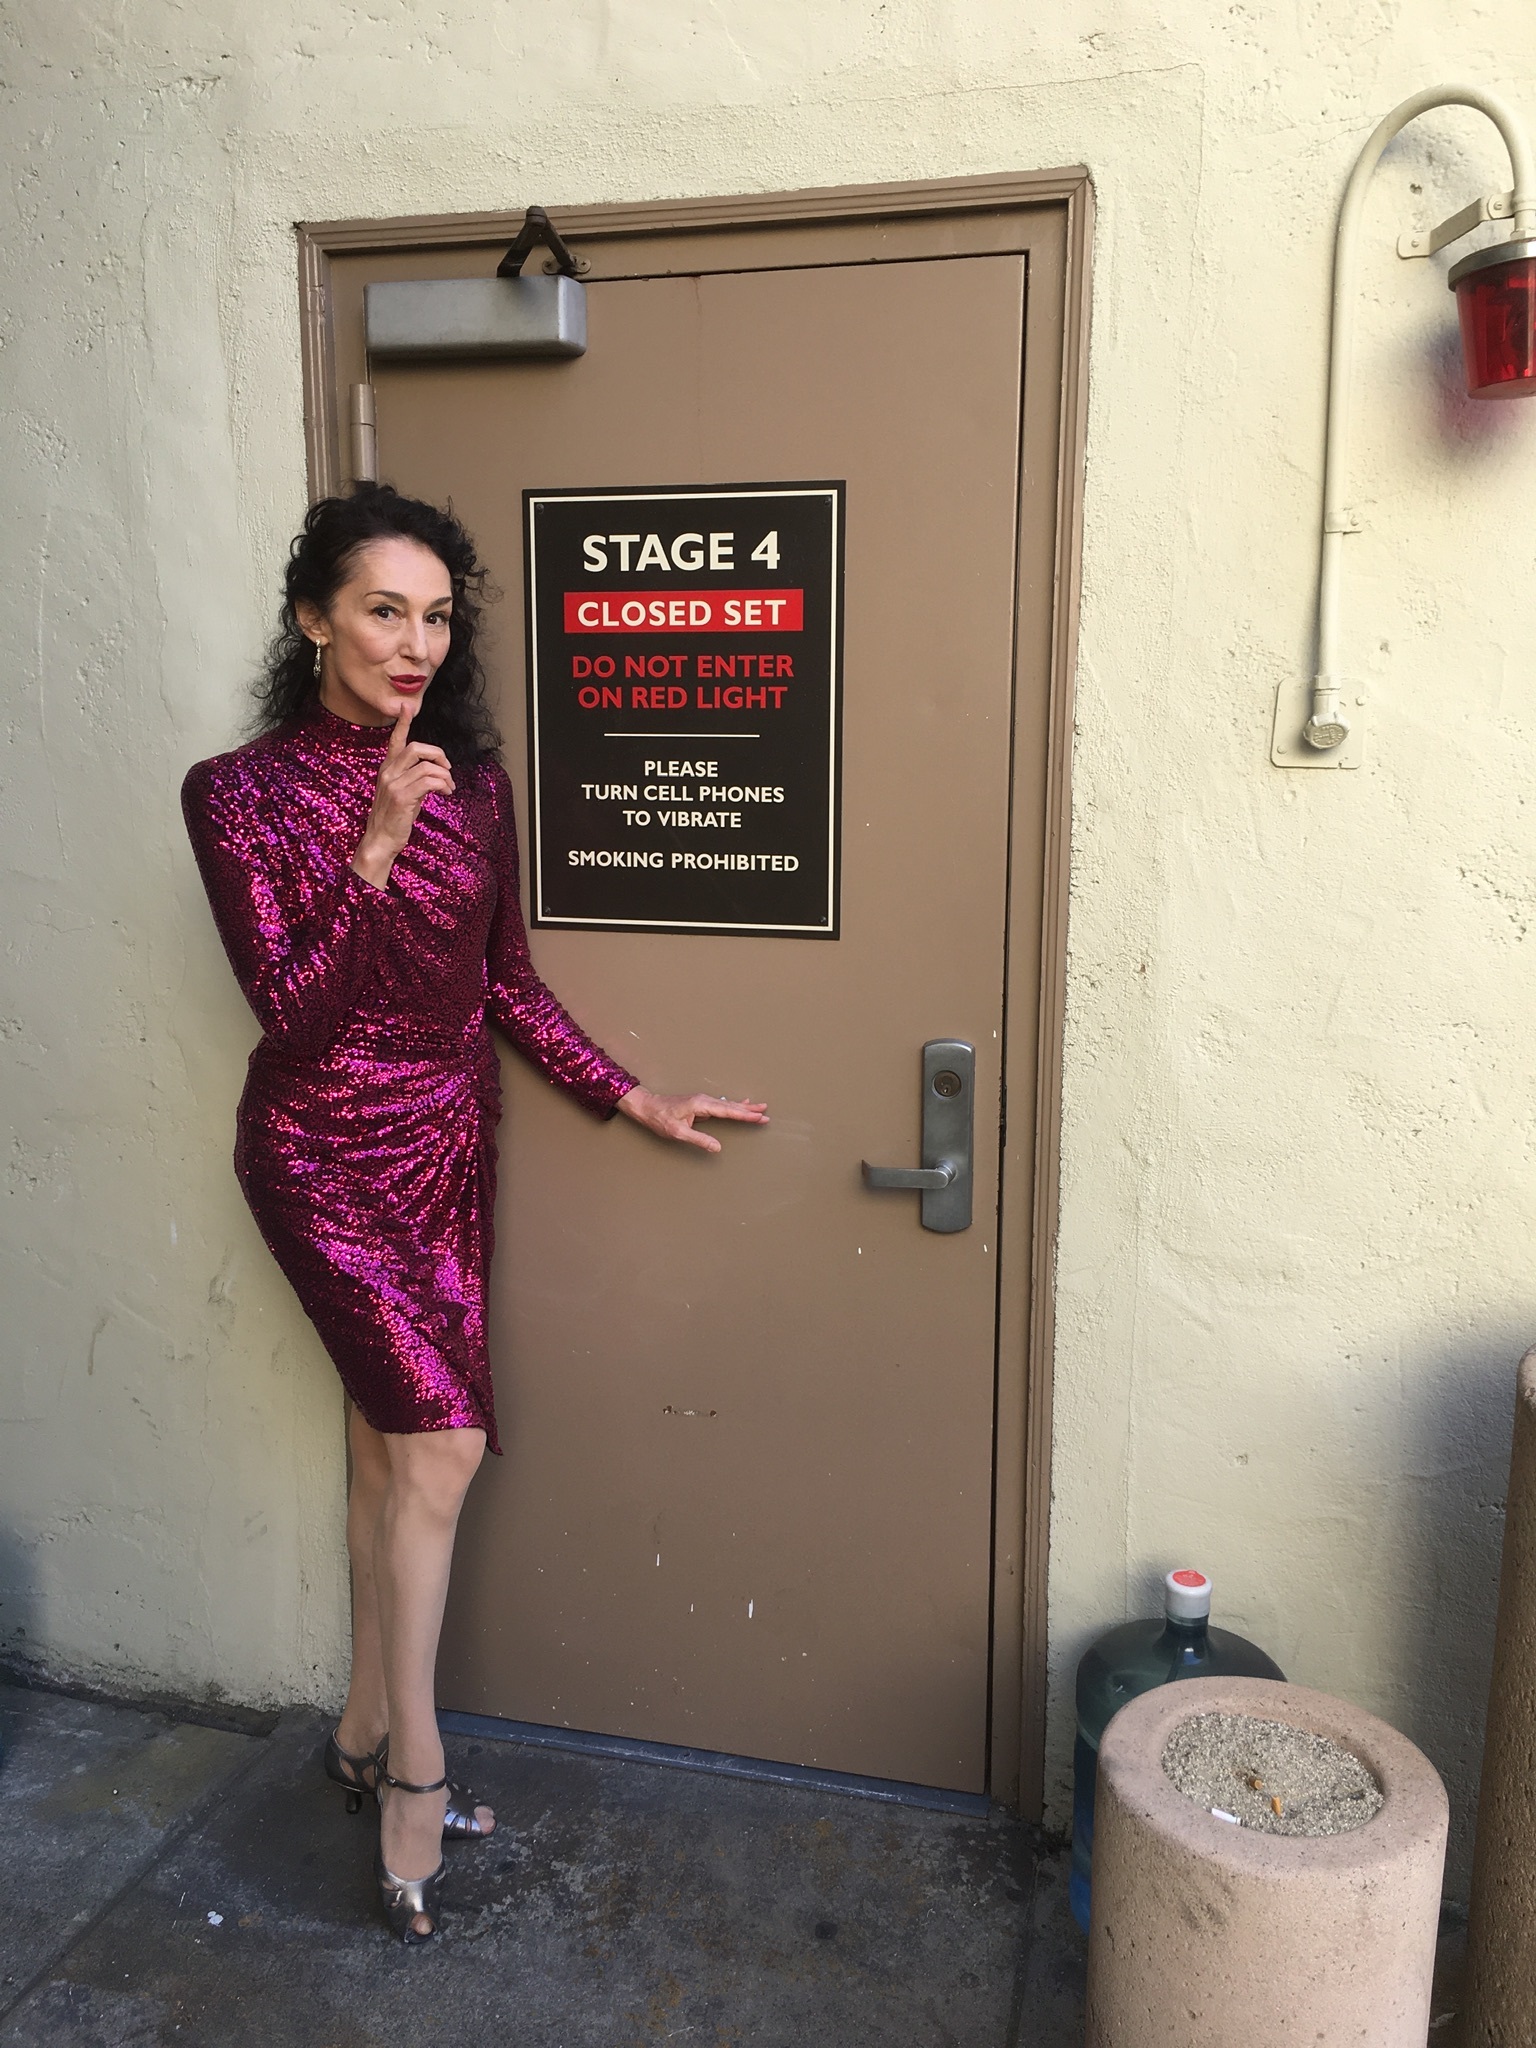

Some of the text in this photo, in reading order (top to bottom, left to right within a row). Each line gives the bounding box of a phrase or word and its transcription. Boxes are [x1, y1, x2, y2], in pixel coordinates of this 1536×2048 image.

[583, 531, 780, 572] STAGE 4
[578, 600, 786, 626] CLOSED SET
[573, 655, 794, 678] DO NOT ENTER
[578, 686, 787, 708] ON RED LIGHT
[645, 761, 718, 777] PLEASE
[581, 784, 784, 802] TURN CELL PHONES
[623, 811, 741, 827] TO VIBRATE
[569, 851, 798, 871] SMOKING PROHIBITED
